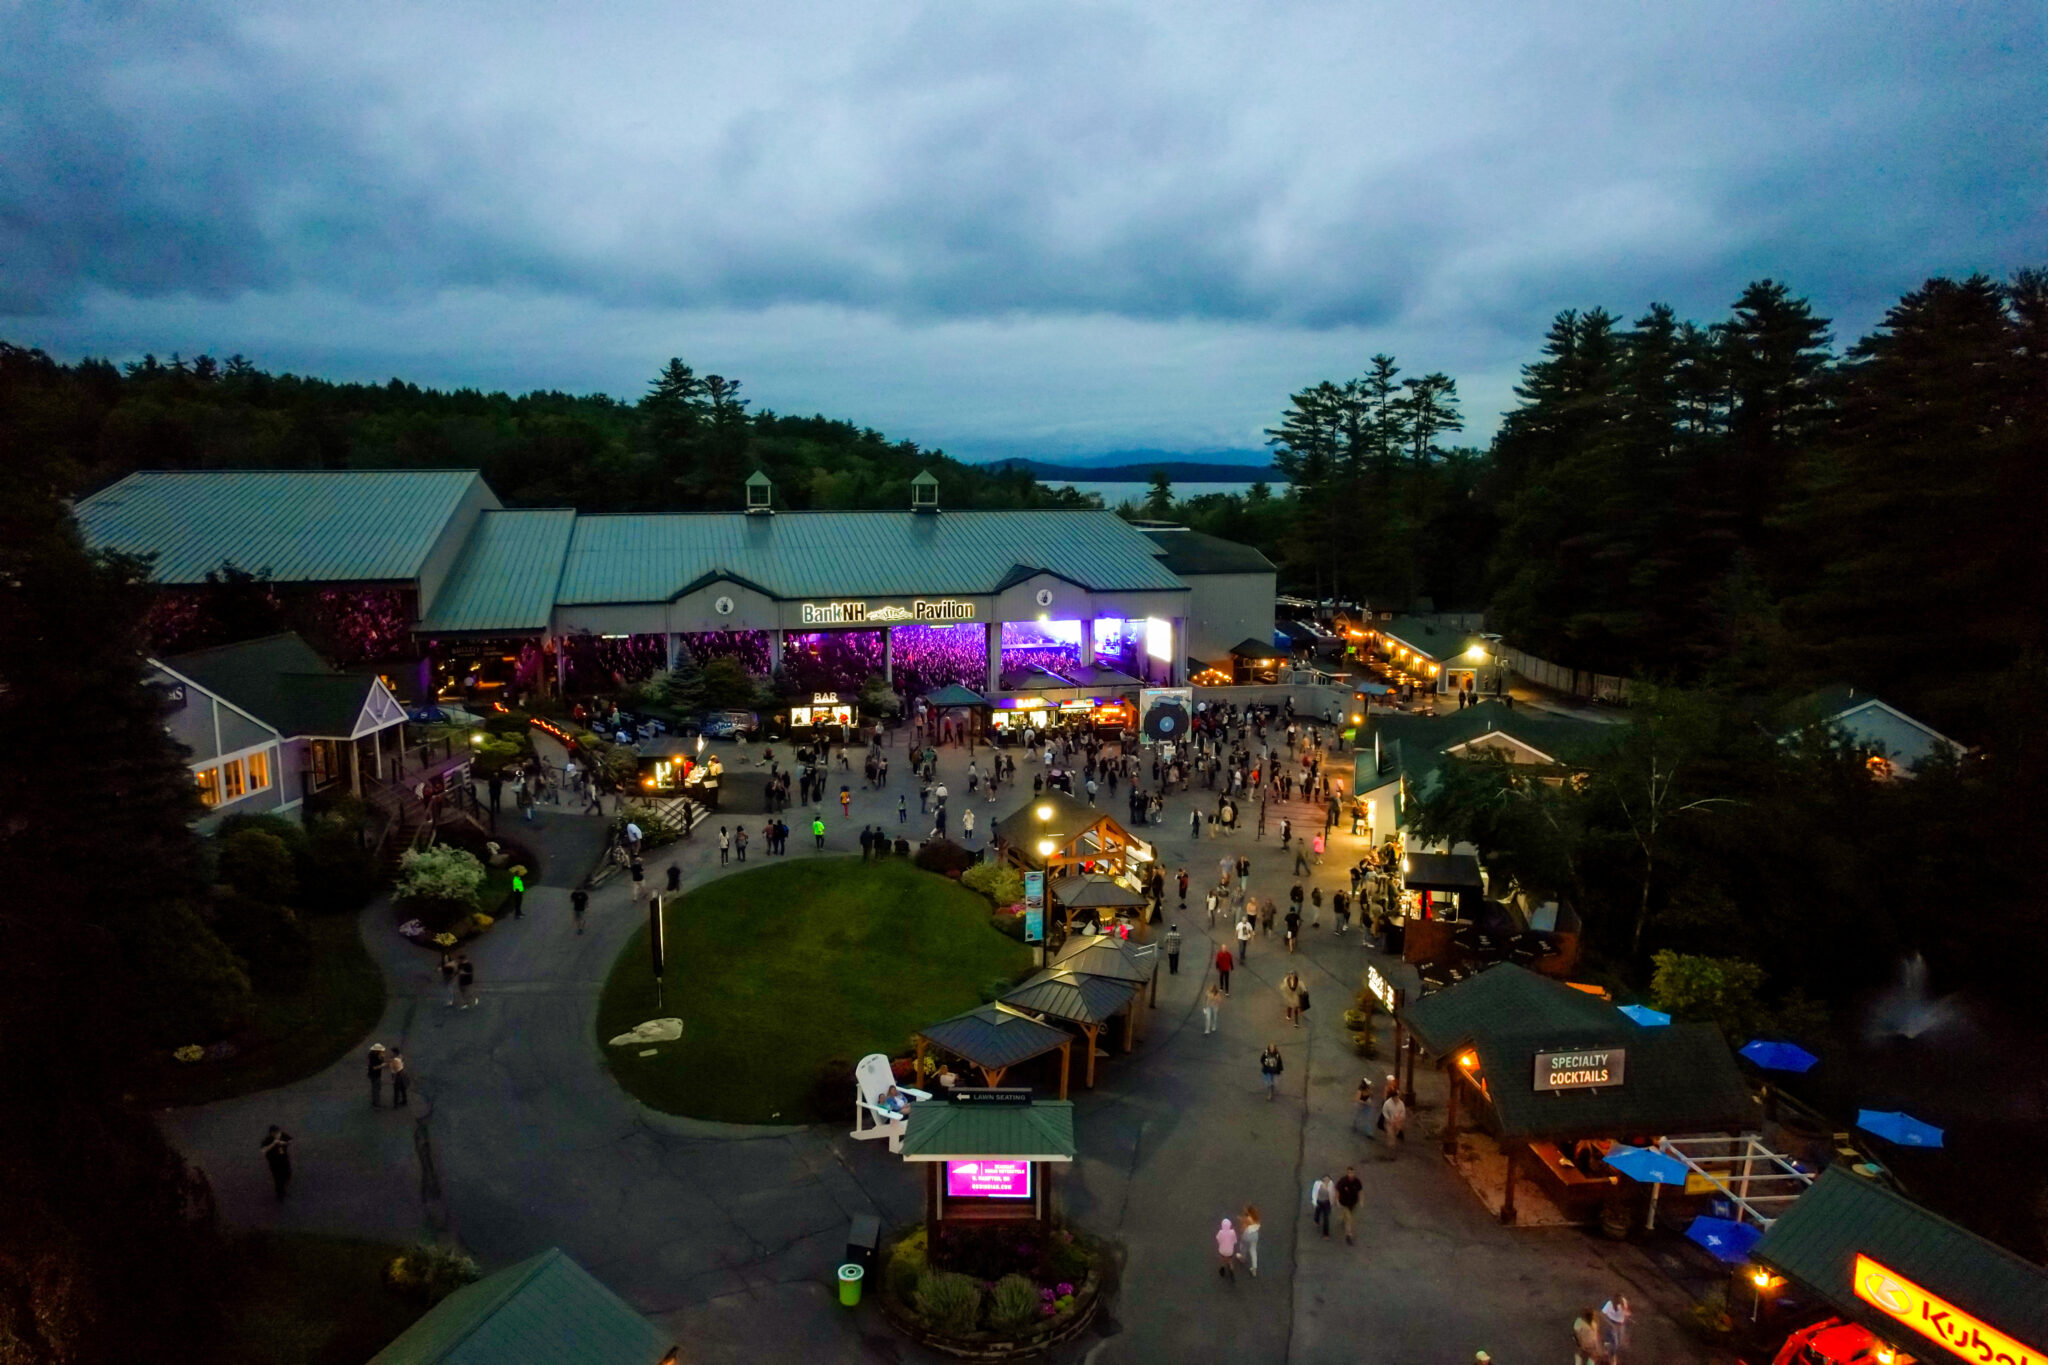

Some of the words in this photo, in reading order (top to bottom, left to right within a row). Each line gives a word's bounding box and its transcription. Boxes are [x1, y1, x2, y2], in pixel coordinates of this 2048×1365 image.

[914, 600, 974, 620] Pavilion
[814, 692, 838, 703] BAR
[1551, 1054, 1608, 1069] SPECIALTY
[1549, 1069, 1608, 1085] COCKTAILS
